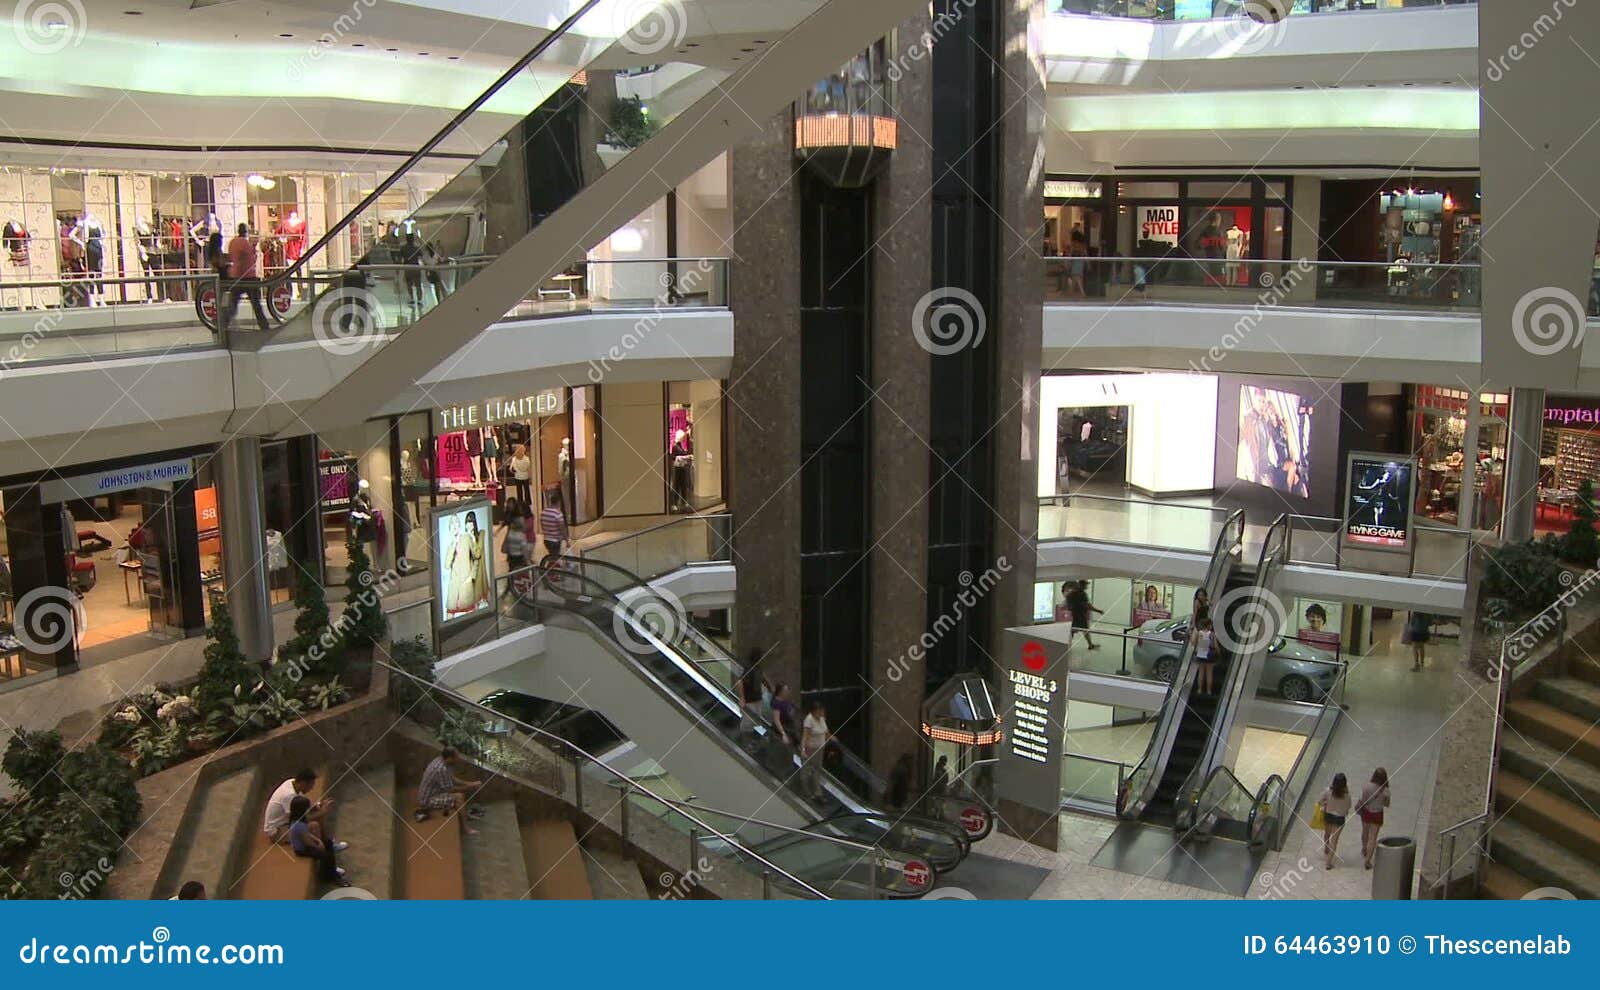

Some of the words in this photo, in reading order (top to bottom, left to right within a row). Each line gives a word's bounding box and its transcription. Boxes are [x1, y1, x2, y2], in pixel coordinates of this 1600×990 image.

[1146, 209, 1175, 222] MAD
[1142, 222, 1179, 235] STYLE
[440, 406, 478, 430] THE
[486, 393, 557, 422] LIMITED
[444, 435, 461, 452] 40
[445, 453, 464, 463] OFF
[331, 465, 347, 474] ONLY
[1380, 528, 1406, 538] GAME
[1009, 669, 1047, 690] LEVEL
[1049, 680, 1057, 692] 3
[1014, 683, 1050, 703] SHOPS
